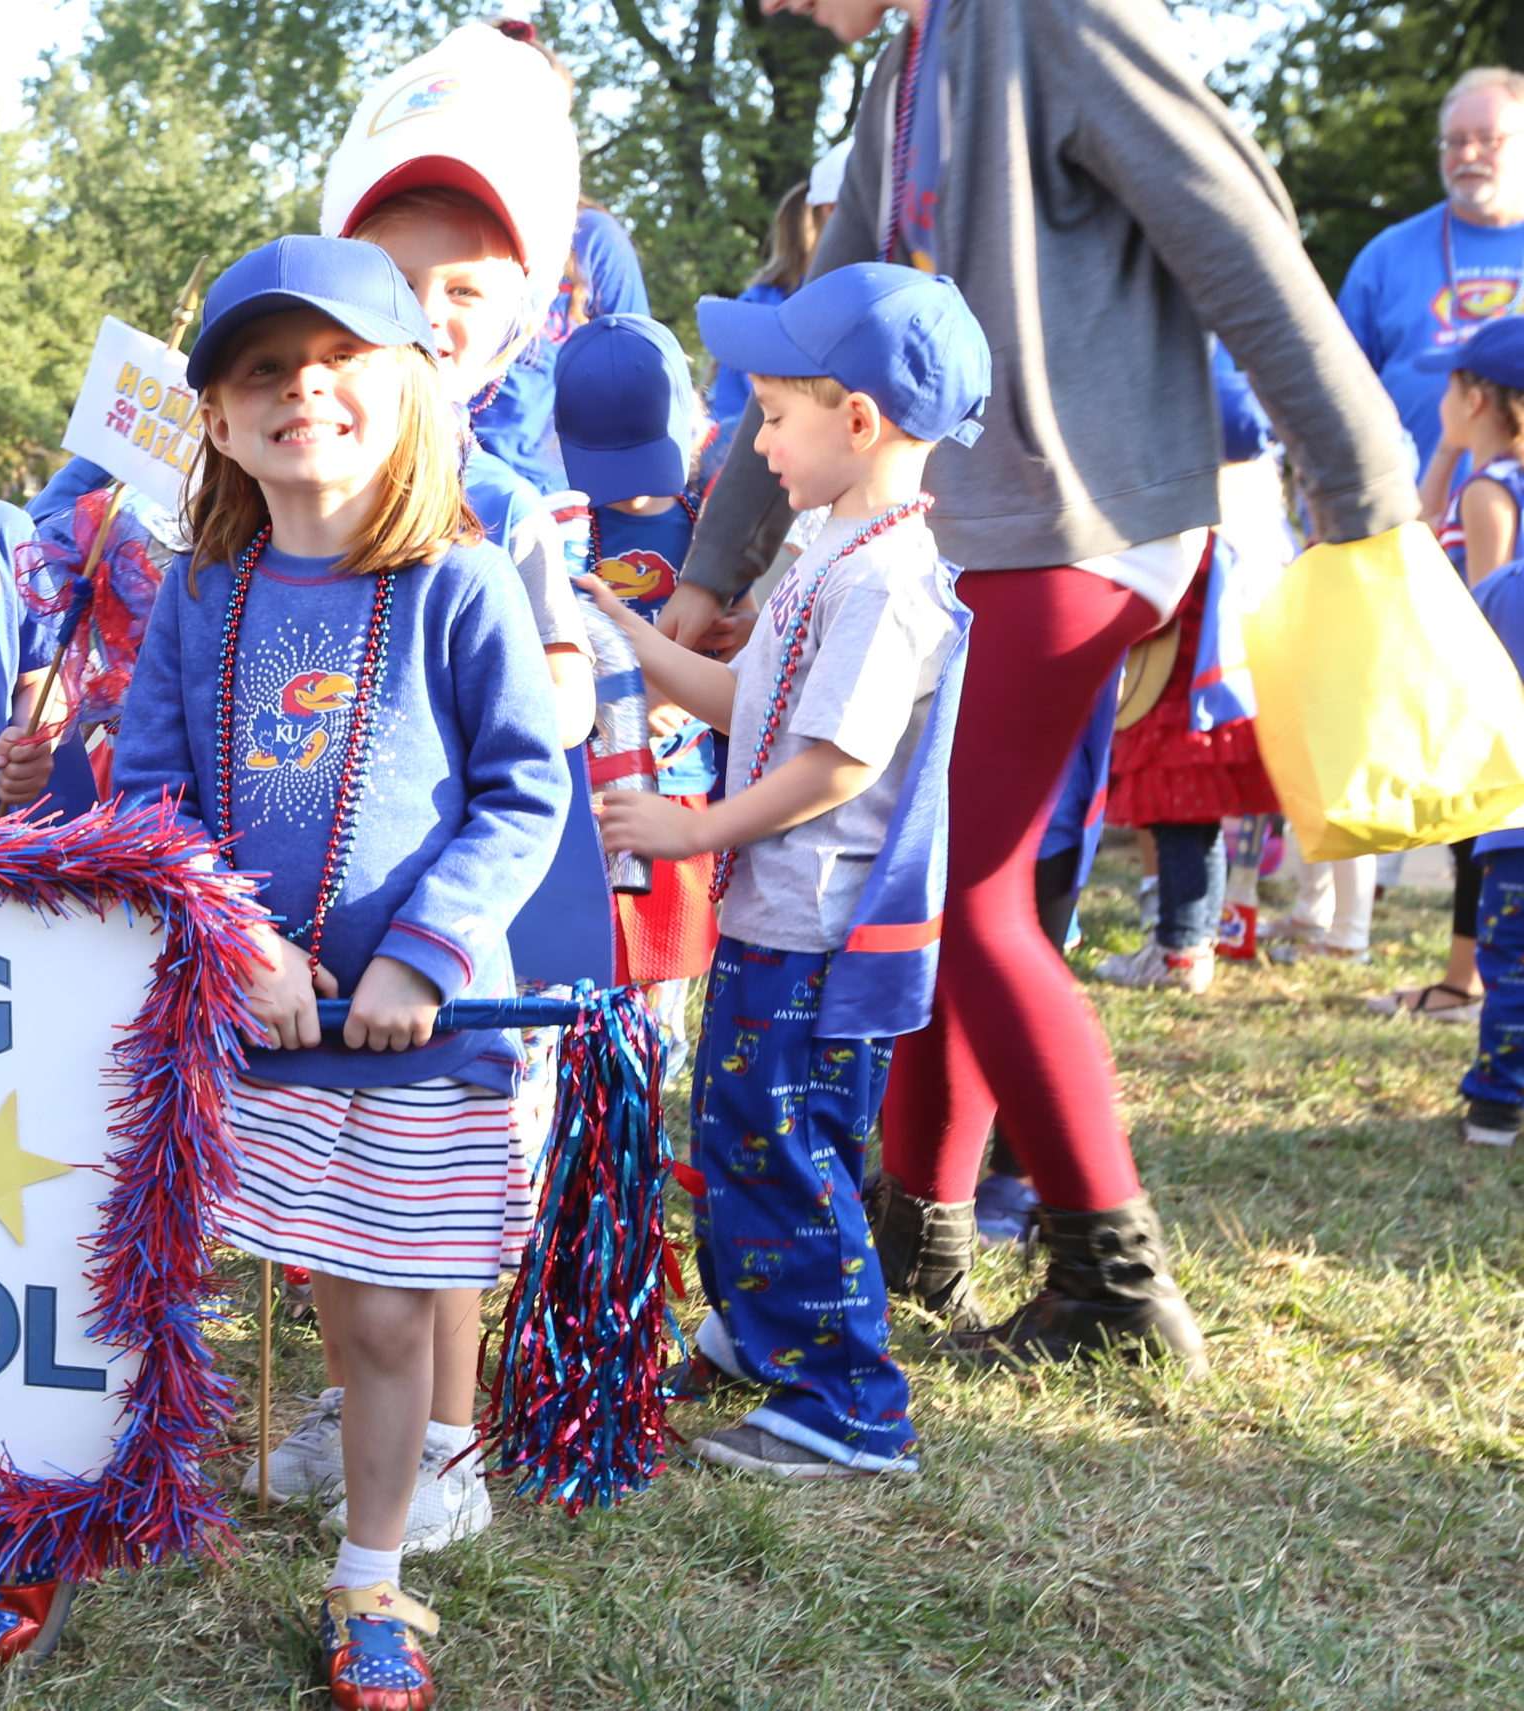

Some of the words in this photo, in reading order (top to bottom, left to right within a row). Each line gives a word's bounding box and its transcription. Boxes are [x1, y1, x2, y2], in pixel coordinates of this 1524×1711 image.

[115, 361, 205, 439] HOME
[116, 398, 138, 421] ON
[105, 411, 132, 437] THE
[275, 724, 303, 744] KU
